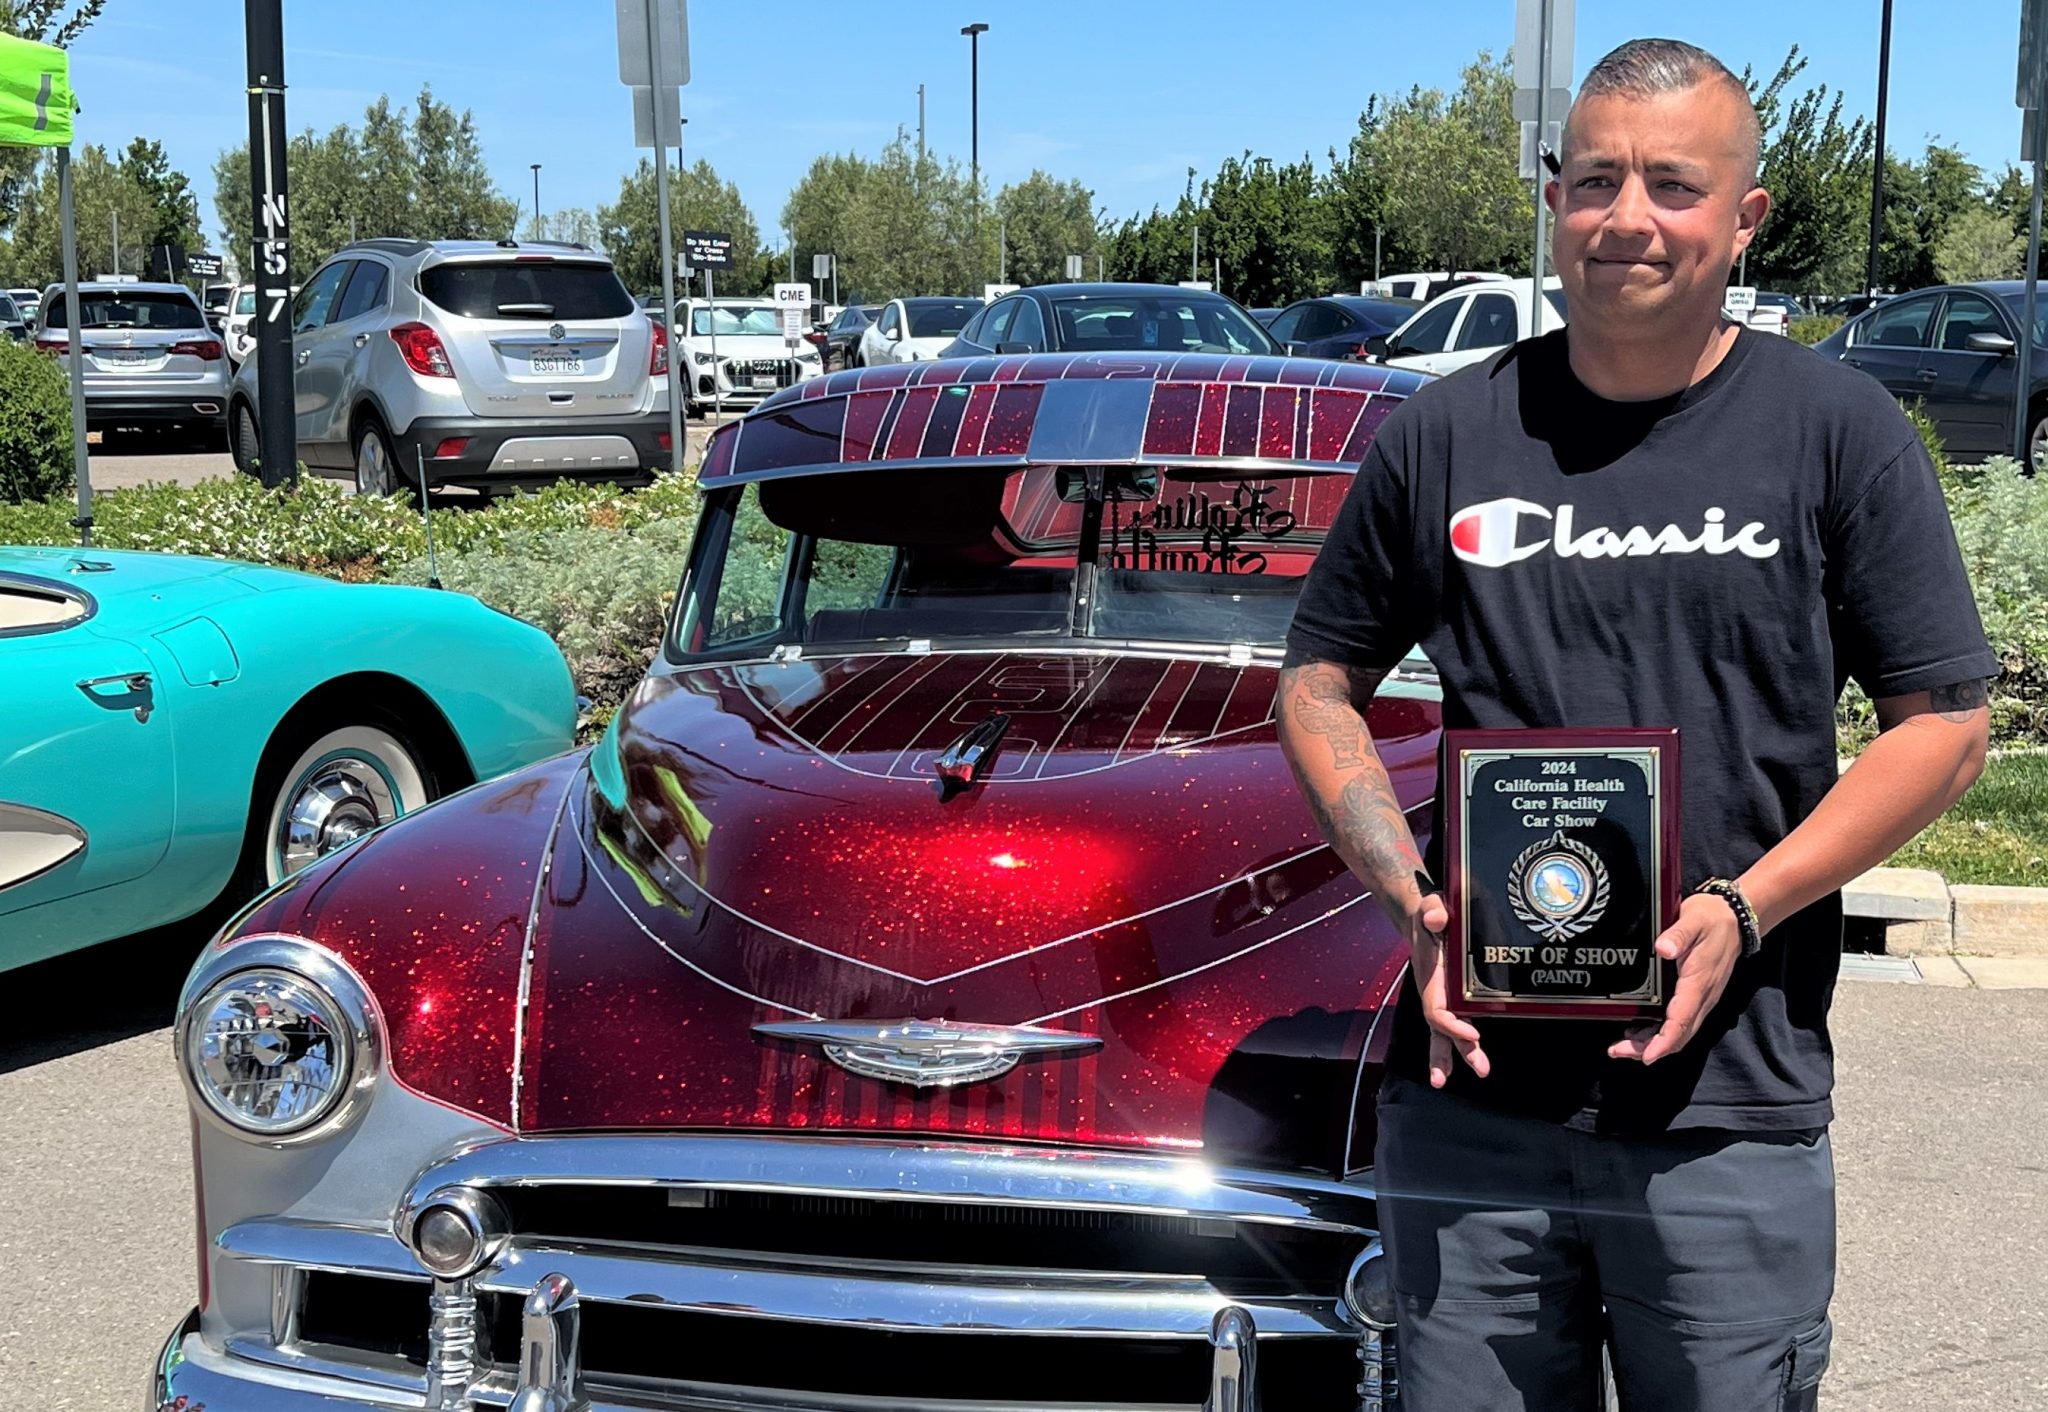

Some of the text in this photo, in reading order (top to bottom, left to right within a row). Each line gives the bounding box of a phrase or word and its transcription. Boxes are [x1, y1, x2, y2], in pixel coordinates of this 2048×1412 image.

[780, 290, 805, 301] CME
[1449, 497, 1780, 568] Classic
[1540, 761, 1577, 774] 2024
[1494, 778, 1625, 793] California Health
[1511, 796, 1608, 812] Care Facility
[1522, 814, 1597, 828] Car Show
[1484, 945, 1639, 966] BEST OF SHOW
[1530, 969, 1592, 987] (PAINT)
